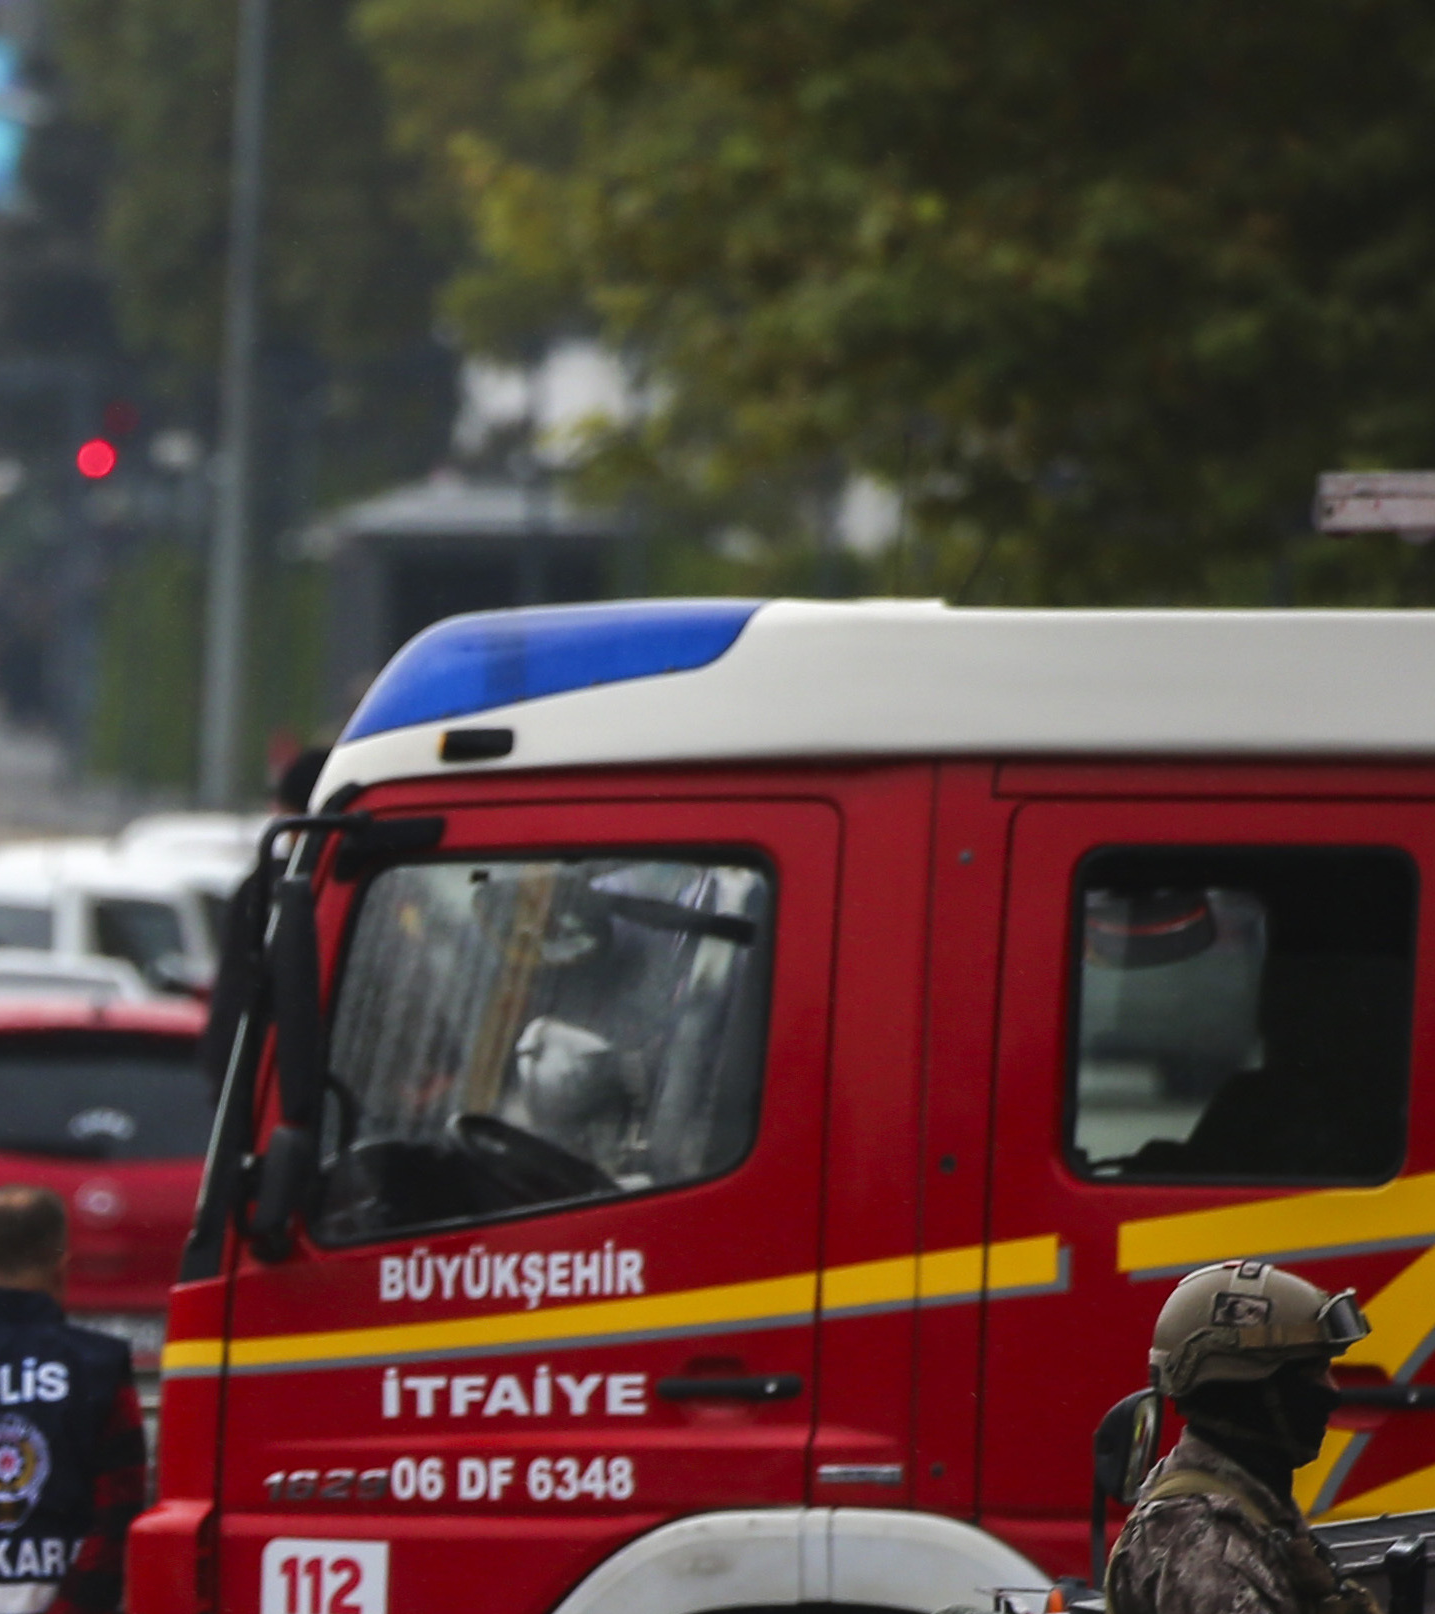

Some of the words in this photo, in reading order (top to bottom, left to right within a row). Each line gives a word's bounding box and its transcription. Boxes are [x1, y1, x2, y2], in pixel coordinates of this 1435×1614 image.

[380, 1240, 644, 1309] BÜYÜKŞEHİR
[382, 1364, 647, 1418] İTFAİYE
[391, 1457, 445, 1501] 06
[458, 1458, 514, 1500] DF
[527, 1456, 634, 1500] 6348
